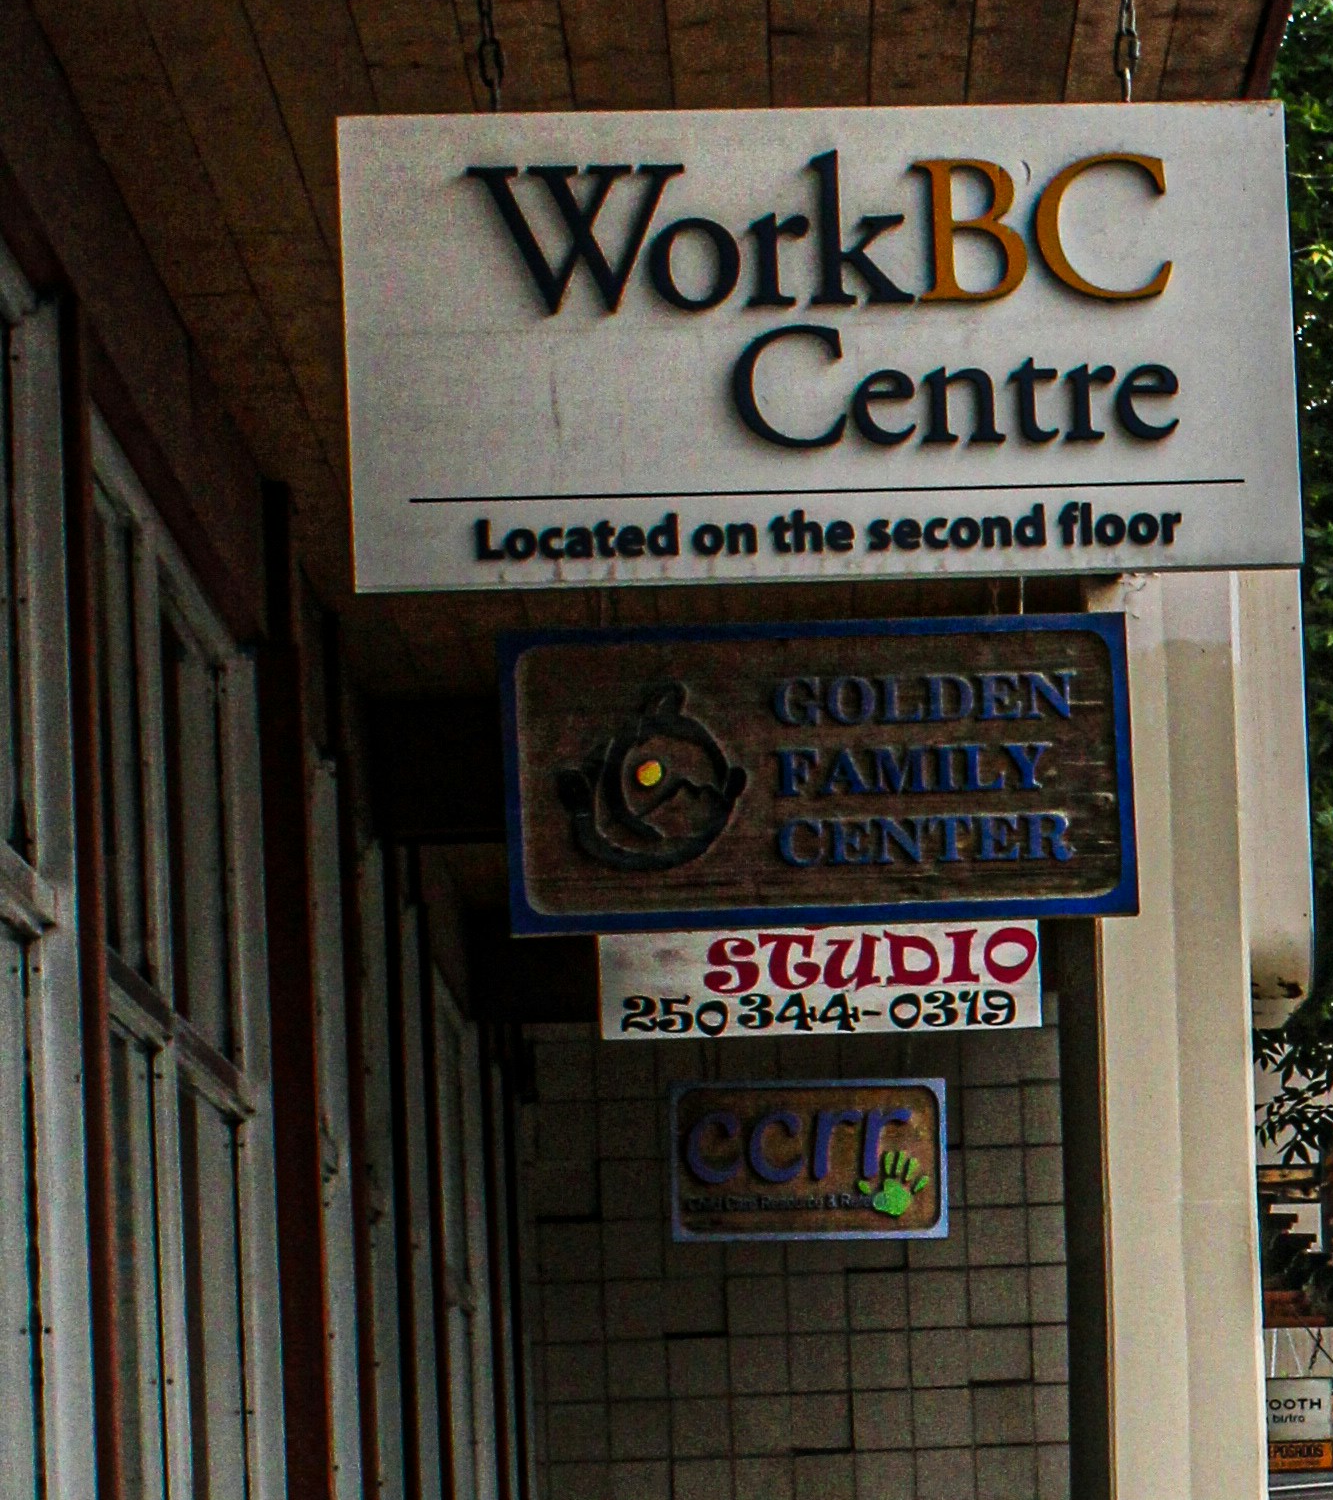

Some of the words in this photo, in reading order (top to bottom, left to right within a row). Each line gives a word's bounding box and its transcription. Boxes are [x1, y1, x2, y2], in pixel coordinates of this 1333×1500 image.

[466, 149, 1172, 315] WorkBC
[733, 324, 1181, 450] Centre
[475, 513, 680, 561] Located
[693, 517, 757, 556] on
[770, 509, 855, 552] the
[868, 504, 1044, 551] second
[1056, 501, 1182, 547] floor
[773, 669, 1077, 727] GOLDEN
[775, 742, 1052, 798] FAMILY
[777, 811, 1077, 868] CENTER
[703, 926, 1038, 994] STUDIO
[621, 994, 729, 1037] 250
[737, 990, 1016, 1032] 344-0319
[685, 1106, 911, 1184] ccrr
[1267, 1398, 1322, 1411] OOTH
[1272, 1414, 1306, 1424] bistro
